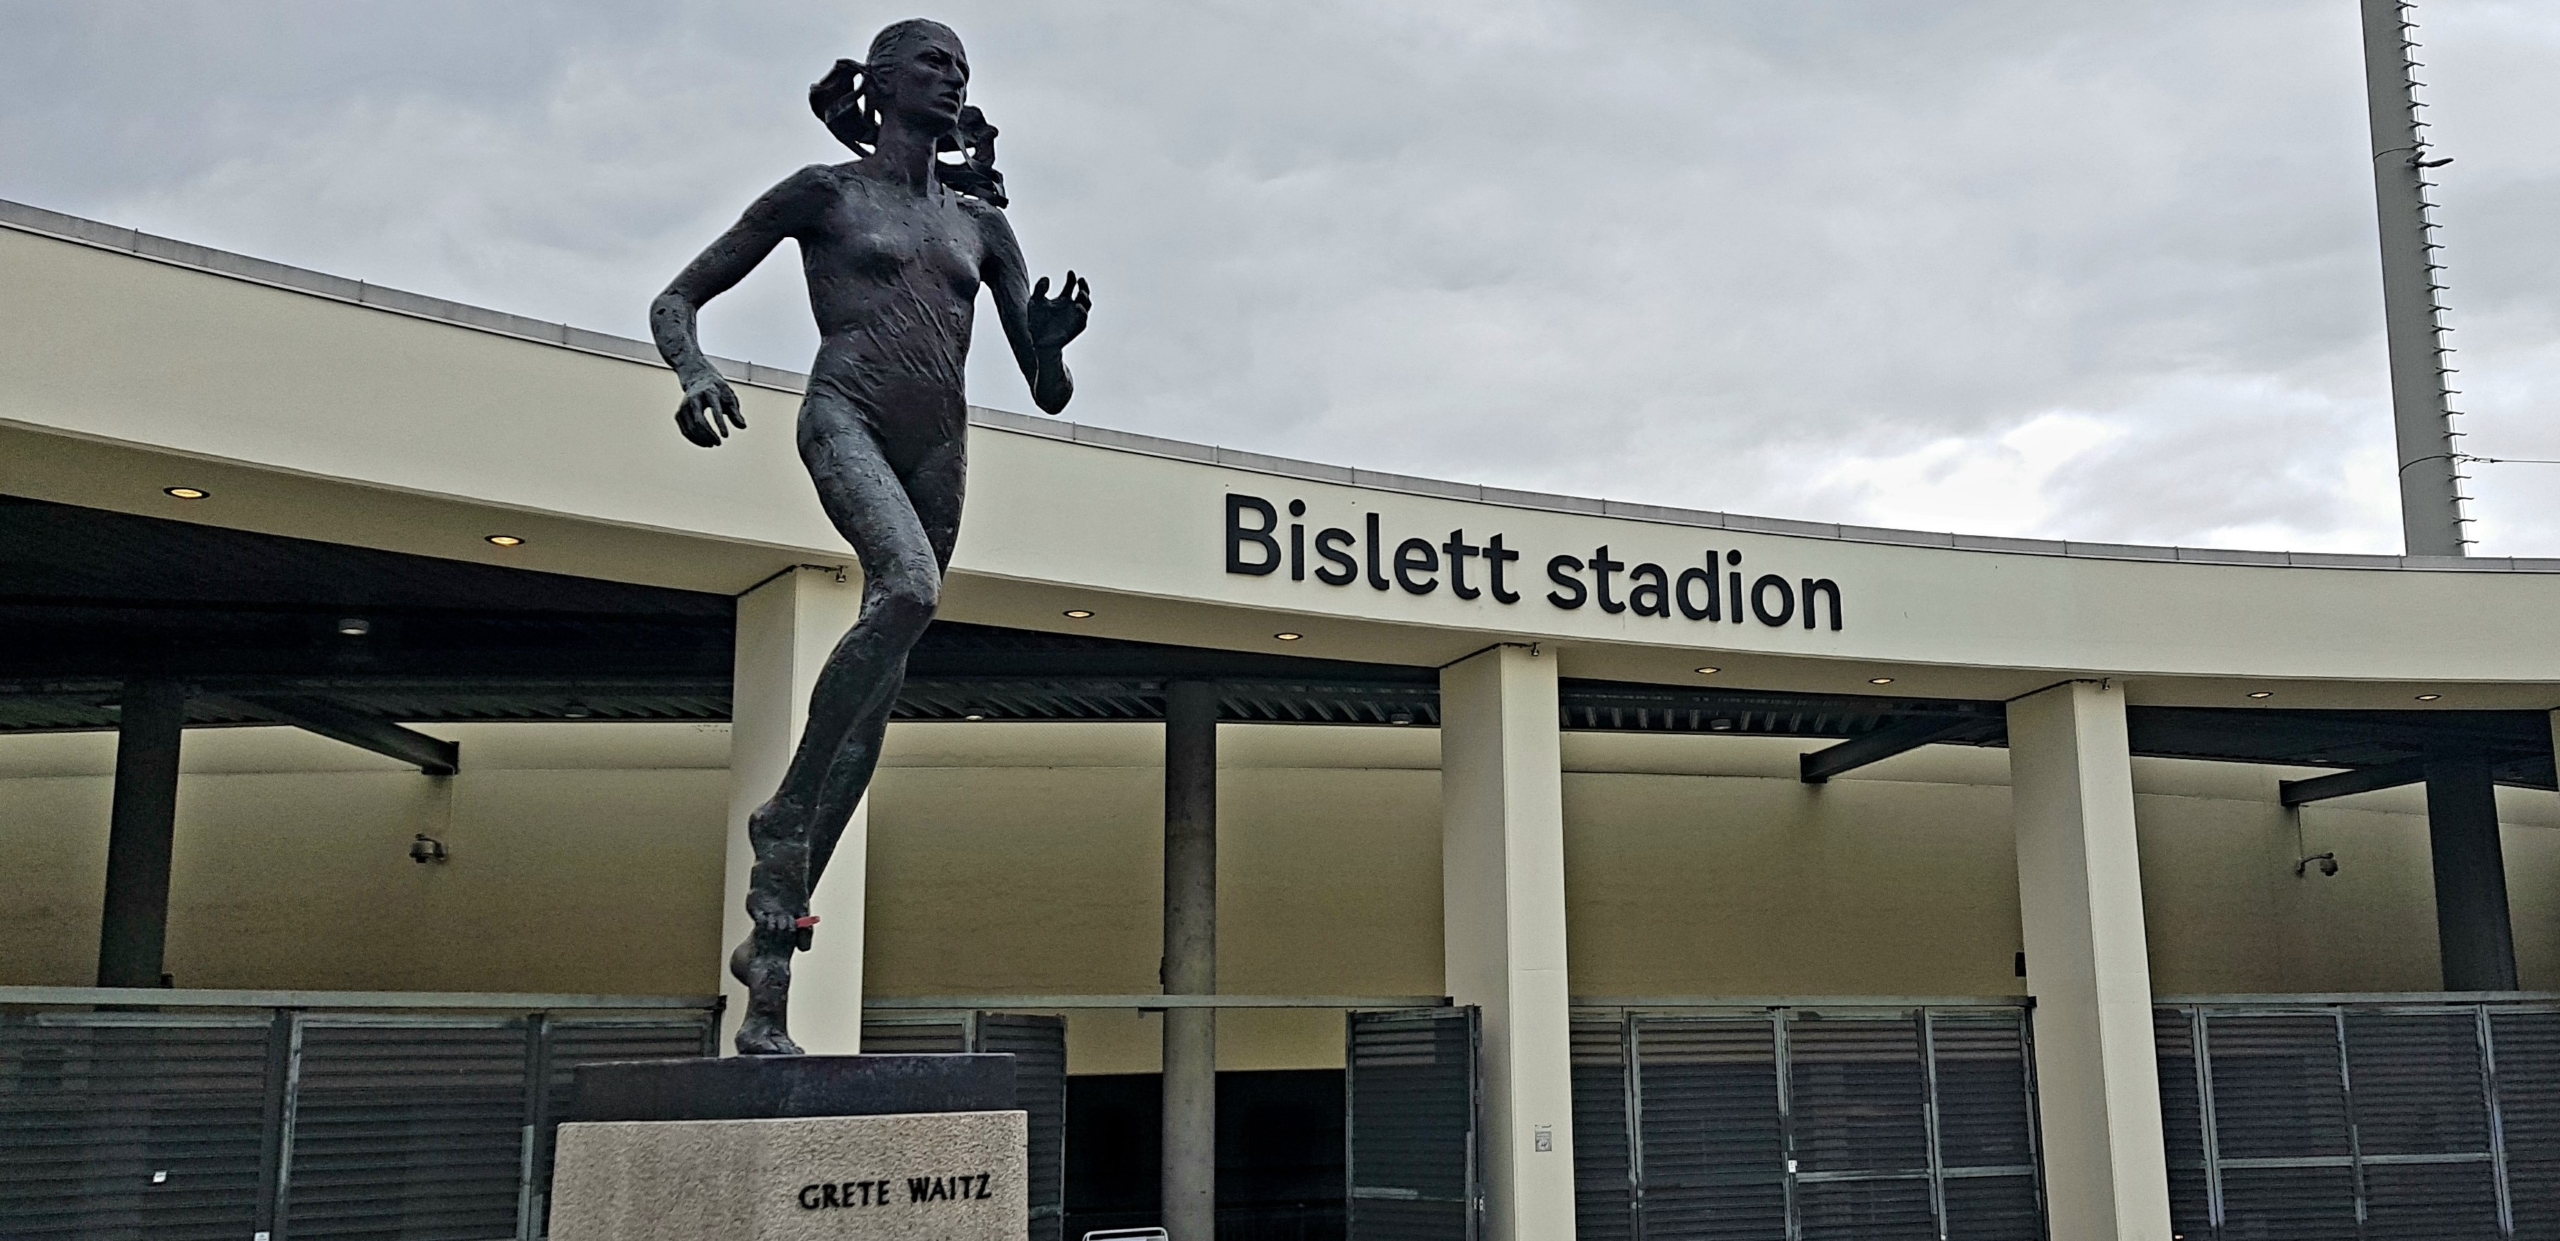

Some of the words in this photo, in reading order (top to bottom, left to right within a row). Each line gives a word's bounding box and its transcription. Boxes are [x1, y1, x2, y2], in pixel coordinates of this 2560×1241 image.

[1225, 492, 1521, 604] Bislett
[1547, 545, 1843, 631] stadion
[798, 1180, 890, 1211] GRETE
[908, 1173, 993, 1204] WAITZ
